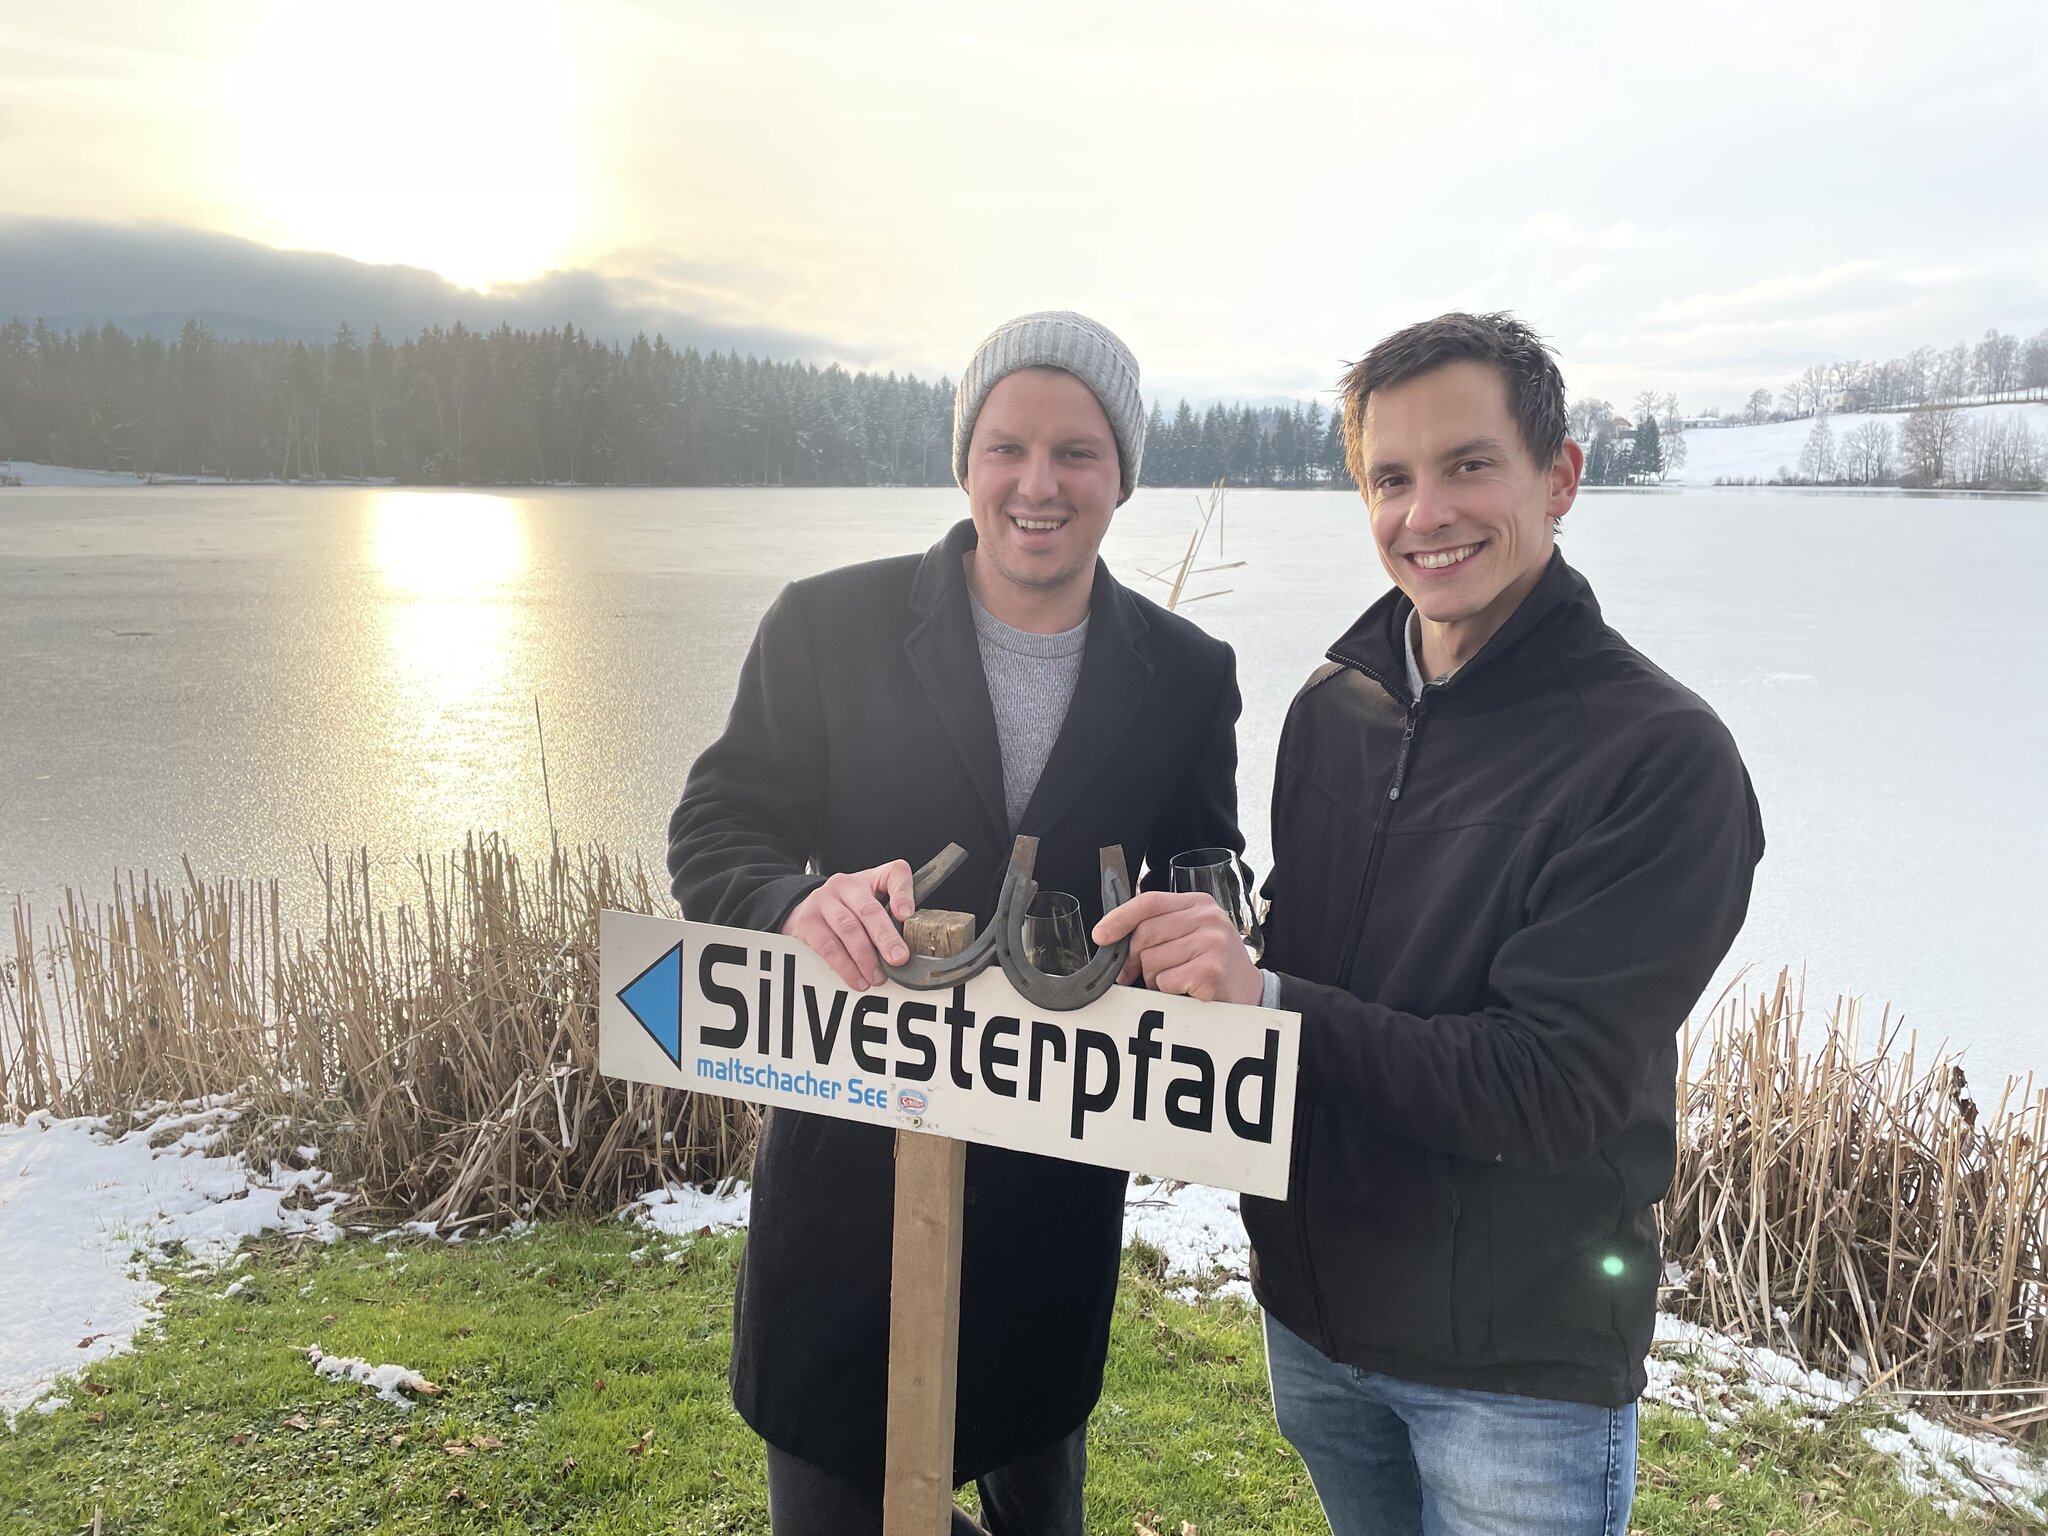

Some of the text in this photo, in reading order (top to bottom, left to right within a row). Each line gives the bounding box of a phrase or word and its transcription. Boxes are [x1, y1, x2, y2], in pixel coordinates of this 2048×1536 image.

[697, 1057, 888, 1109] maltschacher See
[699, 943, 1279, 1144] Silvesterpfad
